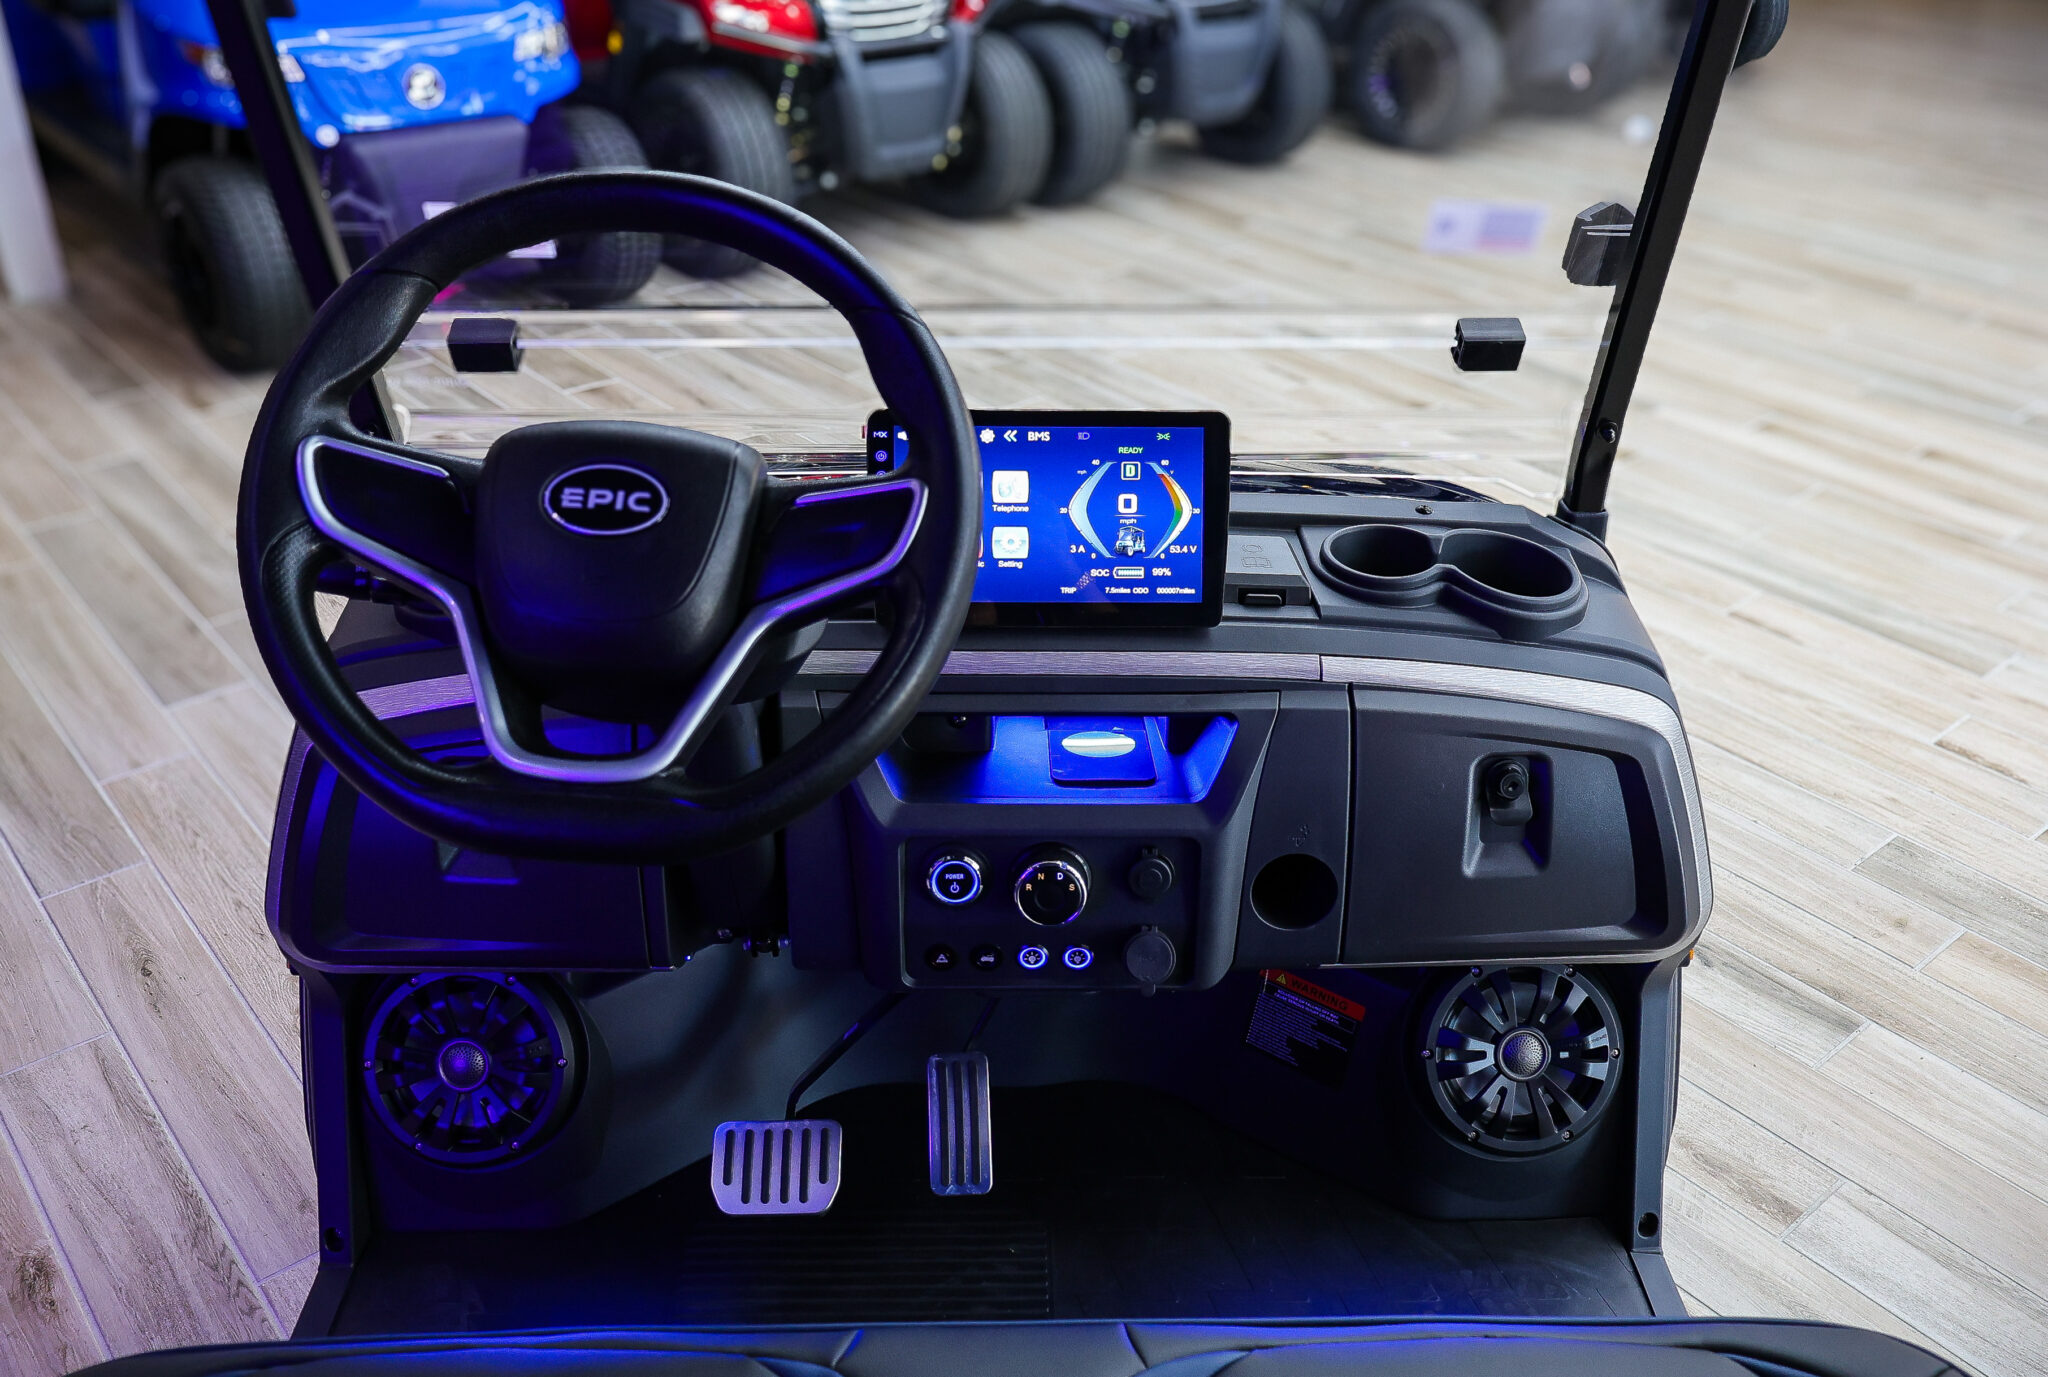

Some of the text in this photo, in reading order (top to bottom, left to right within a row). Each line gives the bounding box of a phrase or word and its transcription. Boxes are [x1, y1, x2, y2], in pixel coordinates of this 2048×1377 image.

[1027, 431, 1051, 442] BMS
[1118, 446, 1144, 454] READY
[1125, 464, 1136, 477] D
[560, 487, 651, 513] EPIC
[1117, 493, 1138, 514] 0
[992, 504, 1030, 513] Telephone
[1070, 544, 1086, 553] 3 A
[1169, 545, 1198, 554] 53.4 V
[998, 560, 1023, 569] Setting
[1090, 568, 1110, 577] SOC
[1151, 568, 1172, 576] 99%
[1056, 872, 1064, 880] D
[1025, 883, 1032, 891] R
[1068, 883, 1075, 891] S
[1290, 979, 1349, 1011] WARNING
